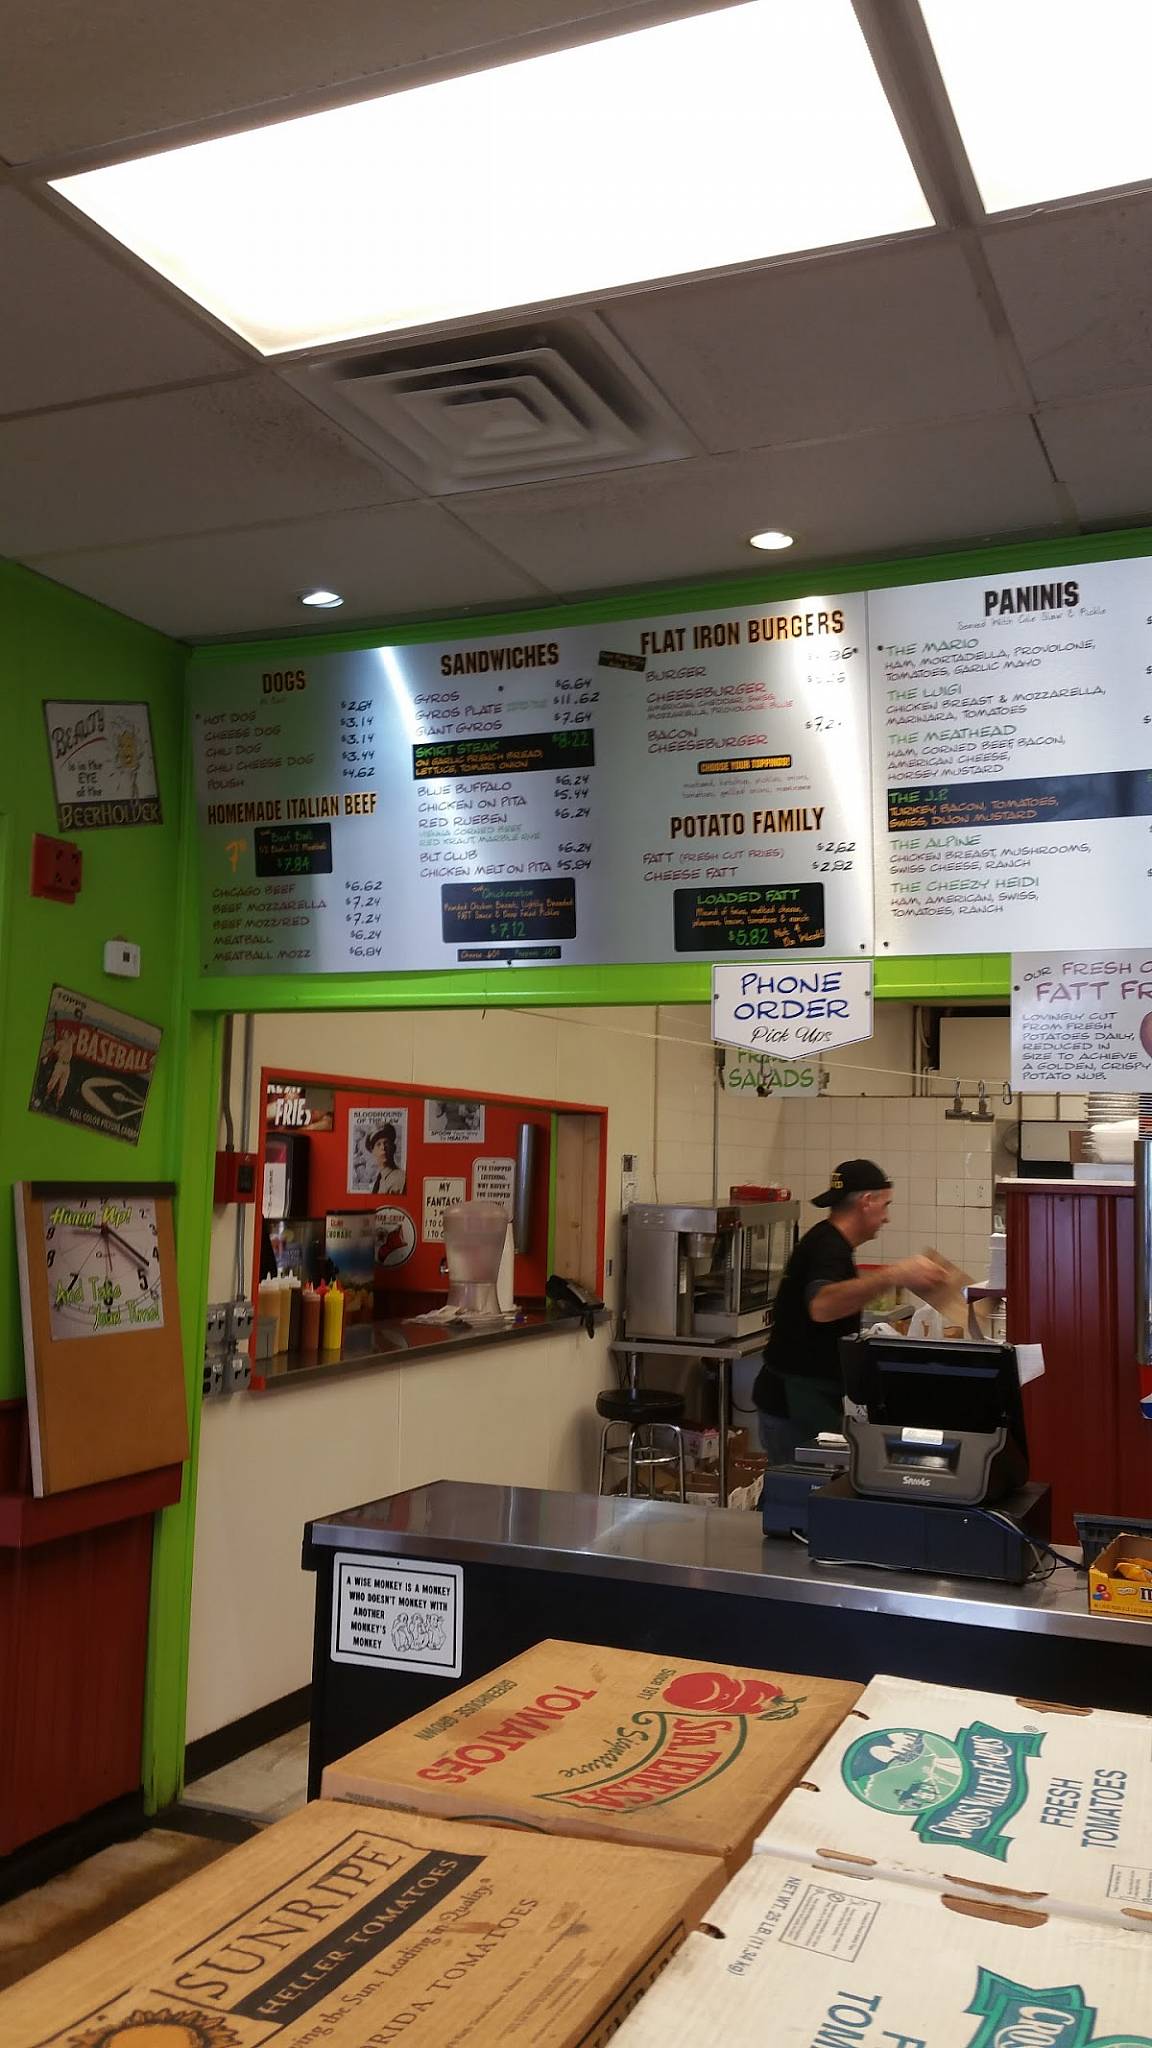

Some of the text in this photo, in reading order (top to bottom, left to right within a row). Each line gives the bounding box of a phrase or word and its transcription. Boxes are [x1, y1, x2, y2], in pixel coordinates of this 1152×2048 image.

[984, 581, 1080, 617] PANINIS
[640, 609, 844, 655] FLAT IRON BURGERS
[886, 638, 980, 657] THE MARIO
[440, 643, 560, 677] SANDWICHES
[954, 658, 1042, 675] GARLIC MAYO
[261, 669, 307, 694] DOGS
[645, 665, 707, 682] BURGER
[414, 691, 460, 705] GYROS
[886, 685, 1107, 715] CHICKEN BREAST MOZZARELLA,
[887, 683, 962, 701] THE LUIGI
[415, 706, 461, 721] GYROS
[464, 703, 503, 717] PLATE
[963, 704, 1028, 719] TOMATOES
[203, 725, 281, 741] CHEESE DOG
[455, 720, 502, 733] GYROS
[648, 727, 698, 742] BACON
[888, 724, 1018, 745] THE MEATHEAD
[415, 741, 500, 758] SKIRT STEAK
[647, 734, 769, 755] CHEESEBURGER
[922, 742, 977, 756] CORNED
[887, 757, 953, 770] AMERICAN
[942, 763, 1005, 778] MUSTARD
[417, 781, 513, 796] BLUE BUFFALO
[417, 796, 528, 813] CHICKEN ON PITA
[888, 791, 921, 804] THE
[207, 792, 378, 825] HOMEMADE ITALIAN BEEF
[974, 809, 1039, 822] MUSTARD
[418, 812, 507, 829] RED RUEBEN
[671, 806, 825, 840] POTATO FAMILY
[890, 834, 982, 851] THE ALPINE
[443, 850, 478, 862] CLUB
[643, 851, 676, 865] FATT
[890, 842, 1093, 864] CHICKEN MUSHROOMS,
[420, 861, 552, 878] CHICKEN MELT ON PITA
[643, 865, 739, 882] CHEESE FATT
[890, 858, 1032, 875] SWISS RANCH
[891, 876, 1040, 893] THE CHEEZY HEIDI
[697, 889, 800, 906] LOADED FATT
[959, 903, 1005, 915] RANCH
[1023, 966, 1052, 982] OUR
[1062, 961, 1132, 976] FRESH
[741, 971, 843, 996] PHONE
[1035, 981, 1110, 1004] FATT
[734, 999, 851, 1020] ORDER
[1022, 1012, 1119, 1021] LOVINGLY CUT
[751, 1025, 833, 1044] Pick Ups
[1022, 1022, 1113, 1031] FROM FRESH
[1022, 1032, 1136, 1041] POTATOES DAILY,
[76, 1027, 150, 1072] BASEBALL
[1022, 1042, 1111, 1051] REDUCED IN
[1022, 1053, 1052, 1061] SIZE
[1079, 1052, 1138, 1060] ACHIEVE
[1022, 1062, 1152, 1072] A GOLDEN, CRISPY
[728, 1067, 815, 1090] SALADS
[1022, 1073, 1072, 1081] POTATO
[346, 1576, 451, 1596] A WISE MONKEY IS A MONKEY
[349, 1591, 448, 1611] WHO DOESN'T MONKEY WITH
[353, 1606, 385, 1619] ANOTHER
[350, 1621, 387, 1635] MONKEY'S
[352, 1636, 382, 1649] MONKEY
[416, 1684, 599, 1784] TOMATOES
[558, 1726, 649, 1779] Signature
[928, 1735, 1013, 1839] CROSS VALLEY FARMS
[1040, 1777, 1084, 1828] FRESH
[1081, 1768, 1128, 1849] TOMATOES
[782, 1876, 802, 1896] NET
[175, 1844, 406, 2001] SUNRIPE
[765, 1910, 783, 1922] 25
[257, 1949, 352, 2015] HELLER
[344, 1858, 460, 1945] TOMATOES
[425, 1898, 540, 1993] TOMATOES
